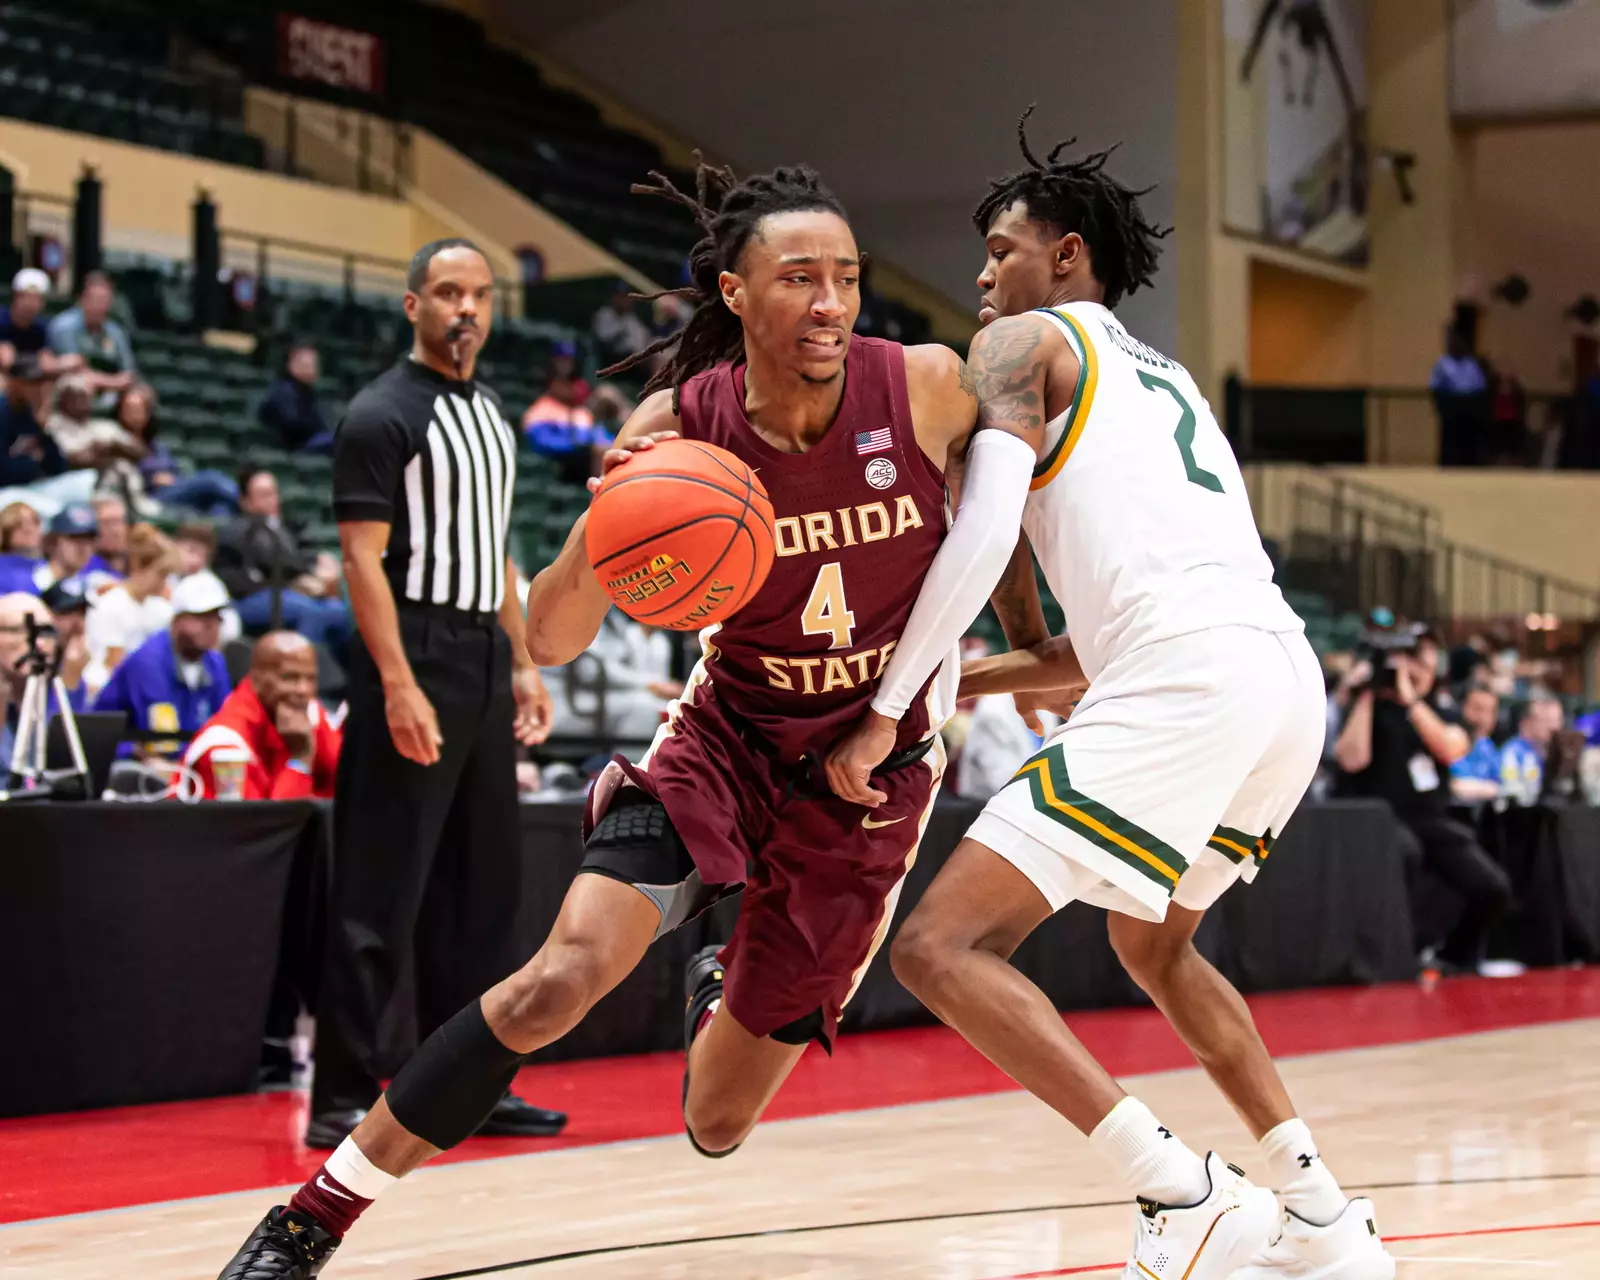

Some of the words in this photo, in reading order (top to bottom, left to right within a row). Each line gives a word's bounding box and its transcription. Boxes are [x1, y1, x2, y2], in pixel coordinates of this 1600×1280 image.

[1136, 368, 1226, 494] 2
[870, 467, 892, 477] ACC
[774, 494, 924, 557] ORIDA
[801, 562, 856, 650] 4
